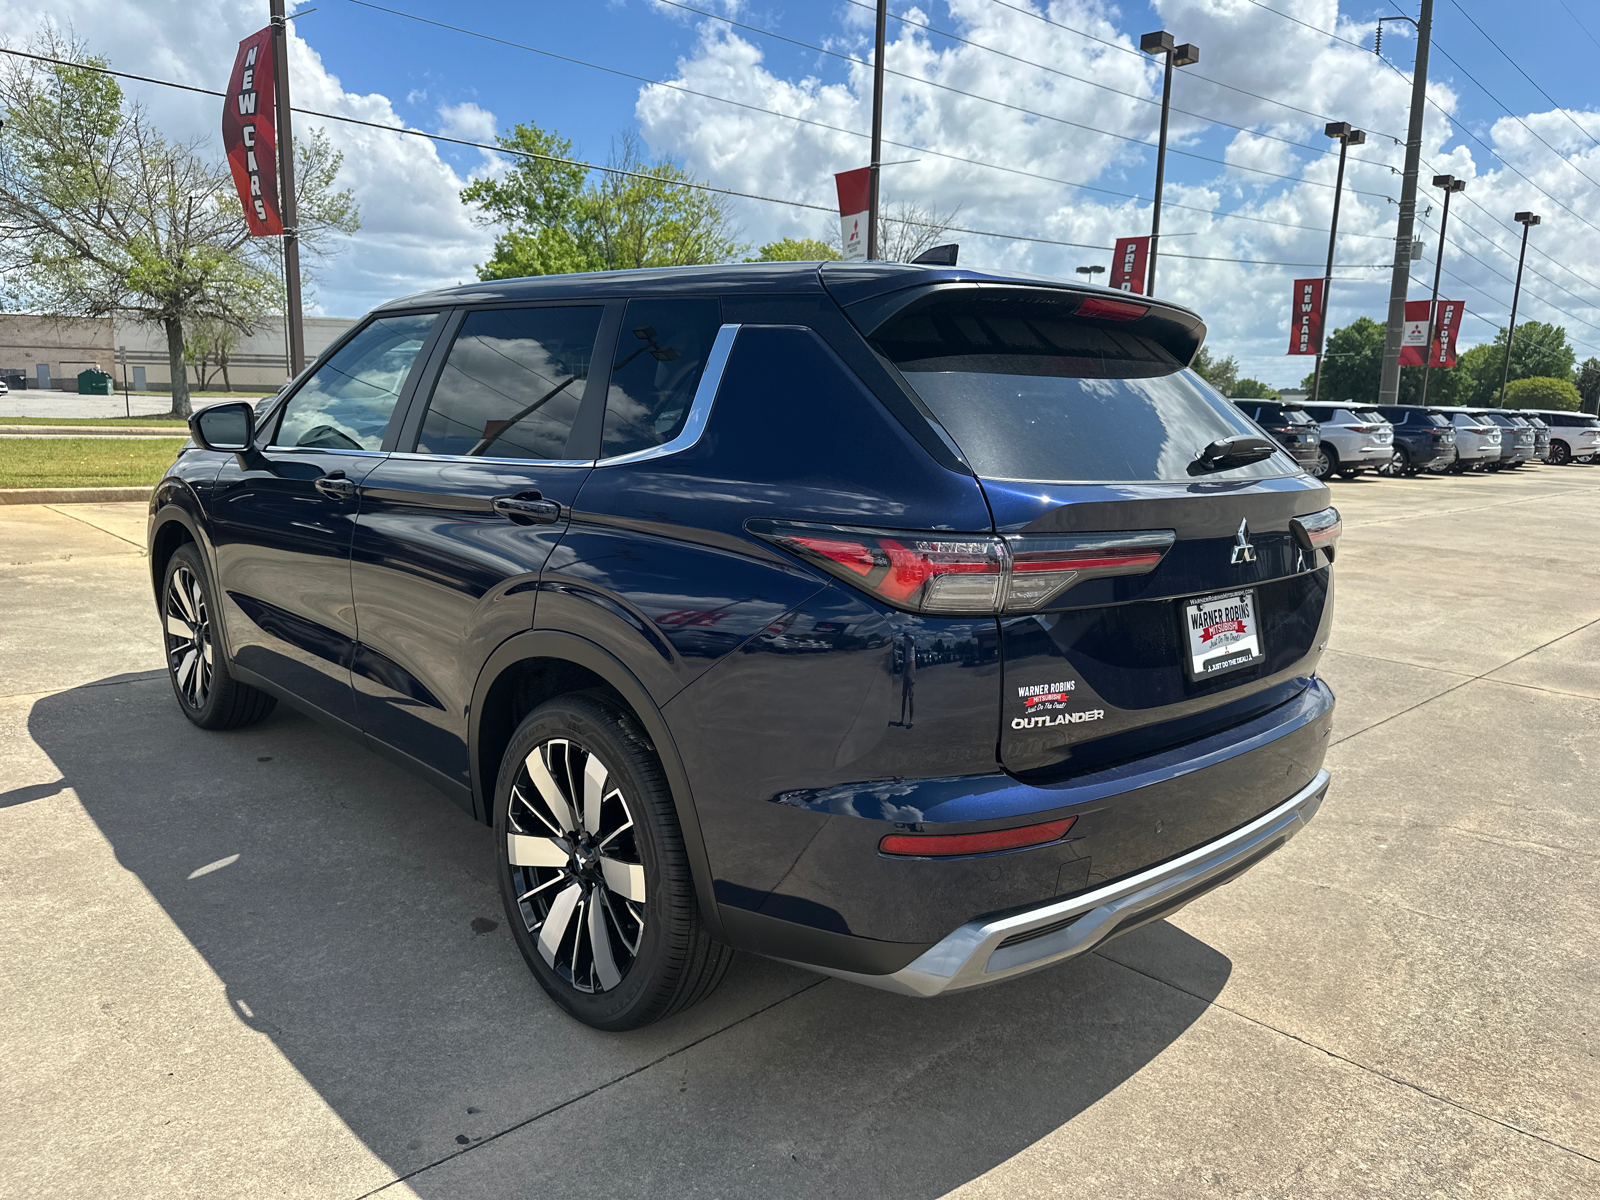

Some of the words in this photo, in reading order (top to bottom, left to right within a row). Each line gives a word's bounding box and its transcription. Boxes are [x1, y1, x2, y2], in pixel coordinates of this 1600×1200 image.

[238, 45, 258, 115] NEW
[243, 124, 266, 220] CARS
[1301, 284, 1313, 313] NEW
[1299, 315, 1310, 352] CARS
[1439, 305, 1454, 363] PRE-OWNED
[1191, 608, 1223, 630] WARNER
[1226, 603, 1250, 622] ROBINS
[1208, 620, 1239, 636] MITSUBISHI
[1212, 662, 1222, 672] JUST
[1222, 661, 1228, 669] DO
[1228, 658, 1237, 668] THE
[1018, 684, 1049, 698] WARNER
[1050, 680, 1076, 694] ROBINS
[1033, 693, 1062, 702] MITSUBISHI
[1011, 709, 1105, 730] OUTLANDER
[499, 731, 528, 793] ROADIAN
